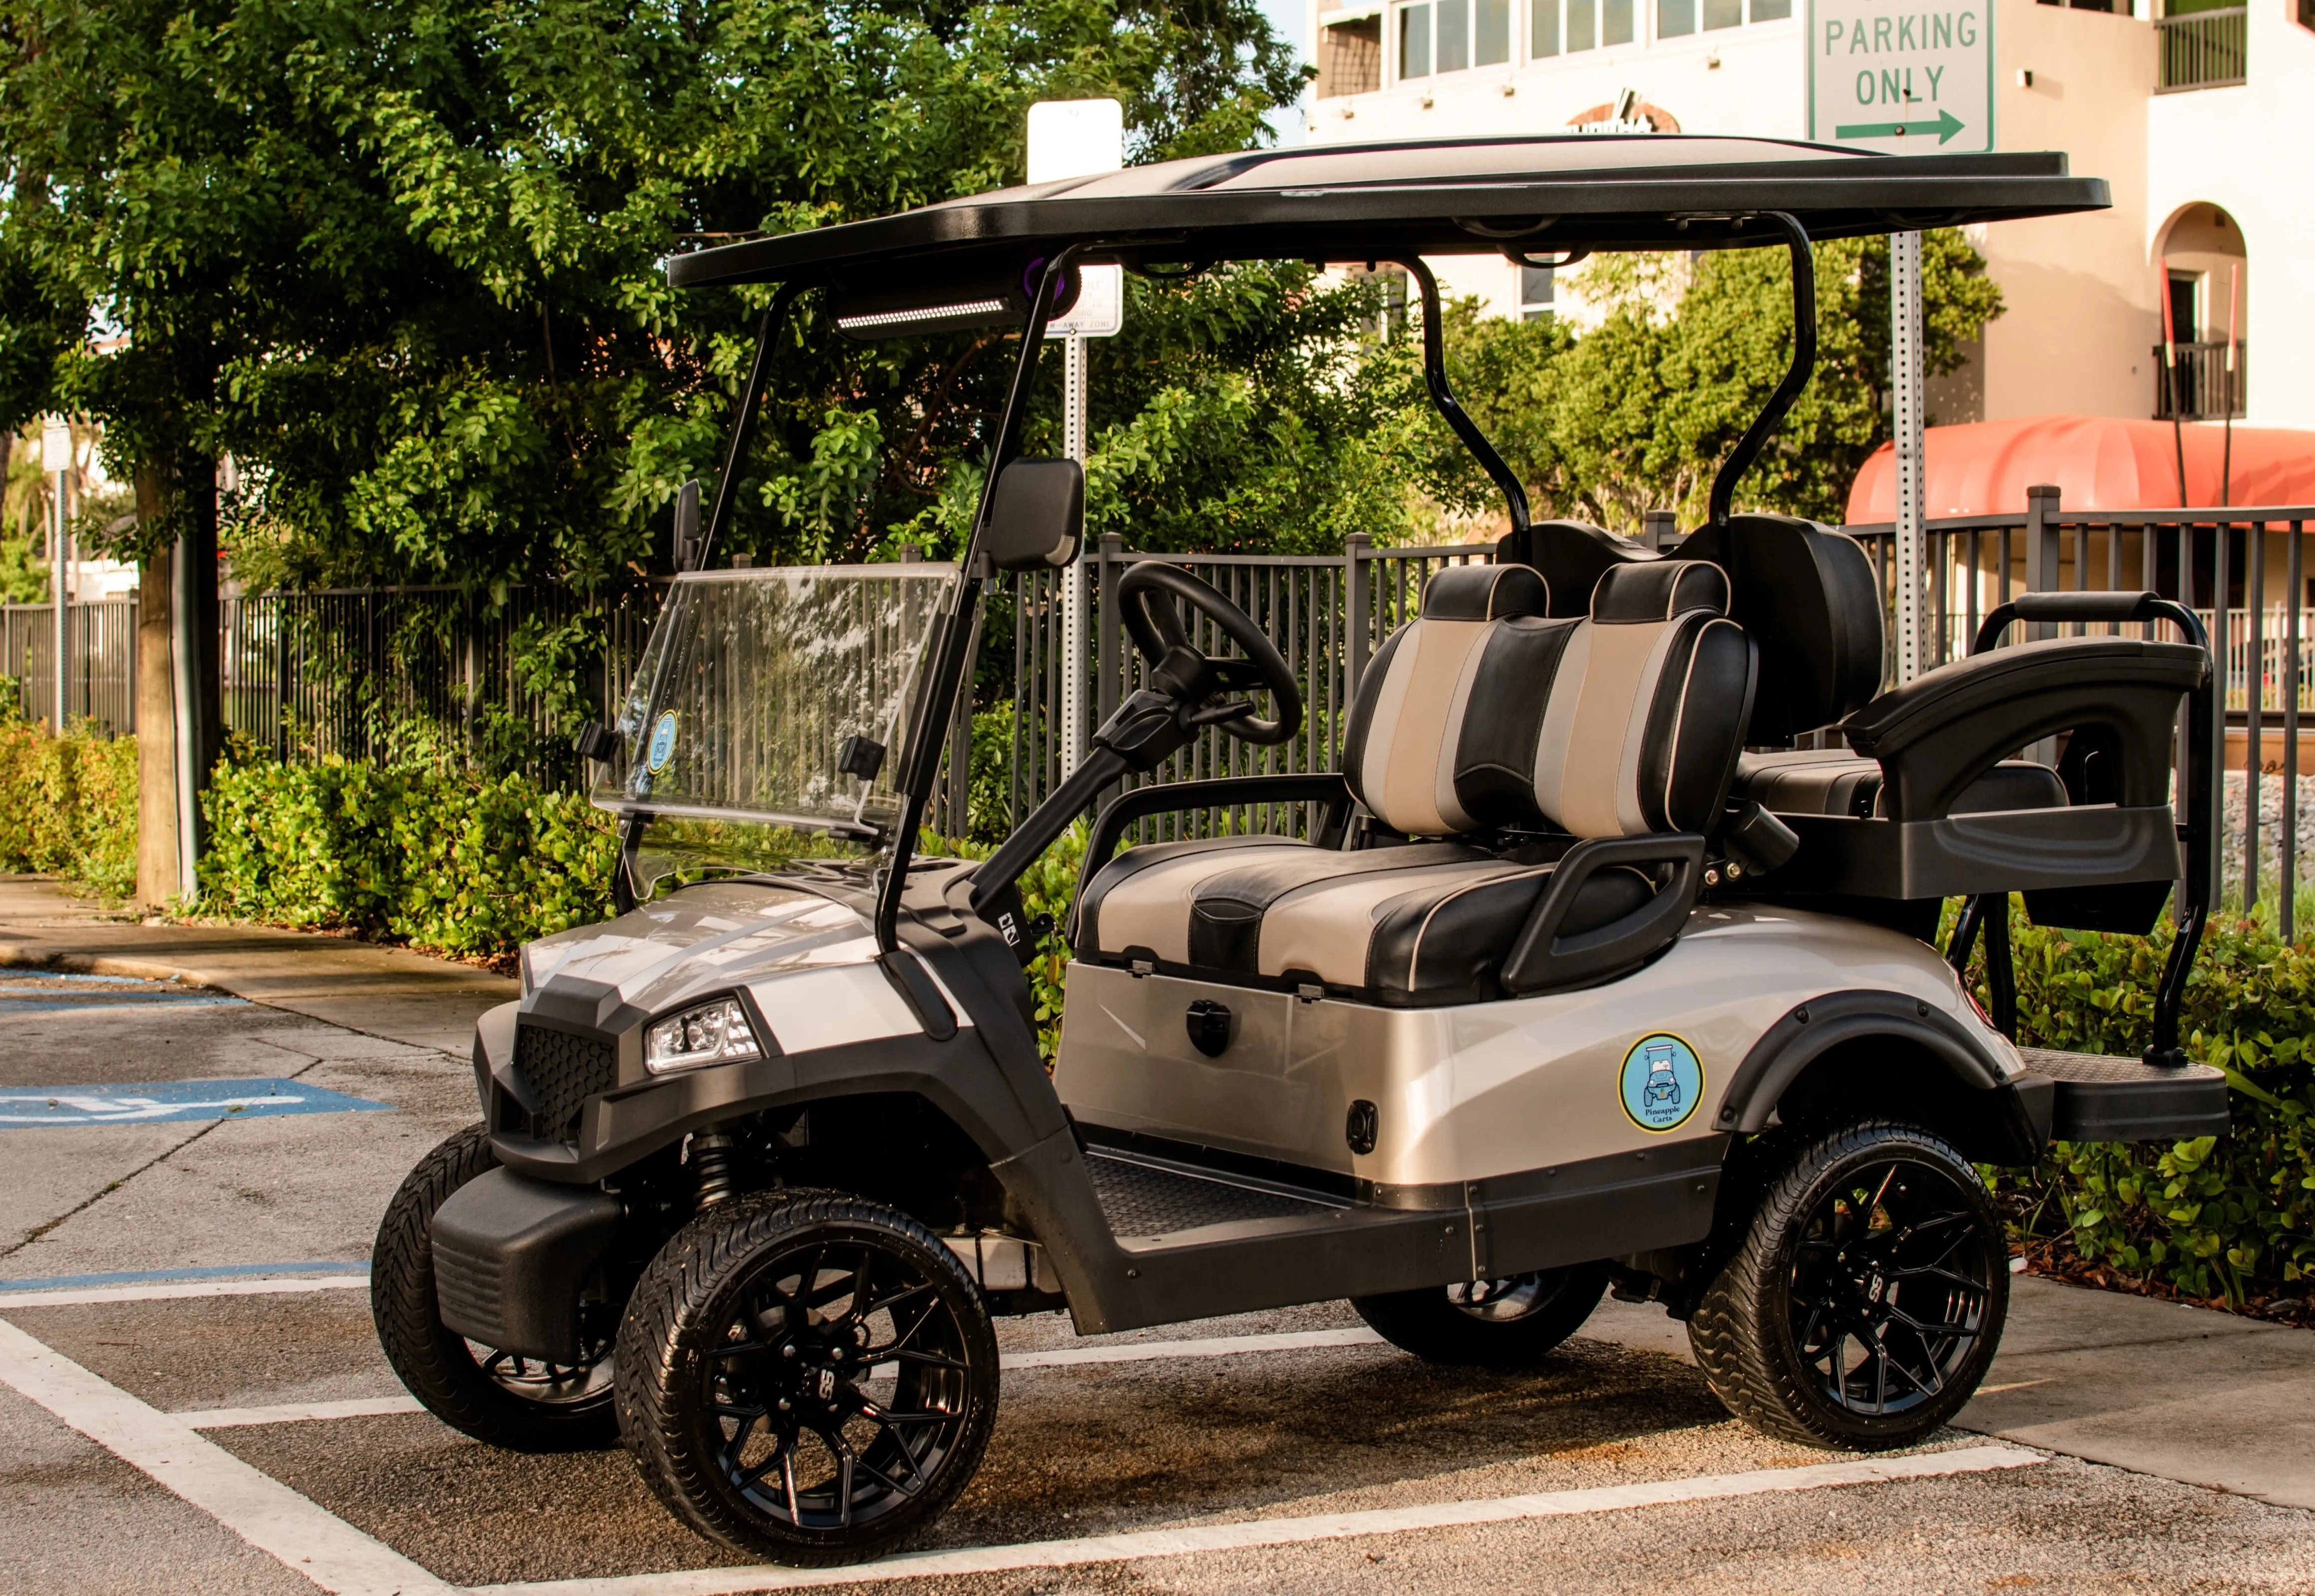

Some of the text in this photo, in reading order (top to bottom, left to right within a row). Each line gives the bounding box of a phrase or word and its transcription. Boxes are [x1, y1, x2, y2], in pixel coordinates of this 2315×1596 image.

[1825, 11, 1976, 55] PARKING
[1856, 65, 1944, 105] ONLY
[1645, 1105, 1680, 1116] Pineapple
